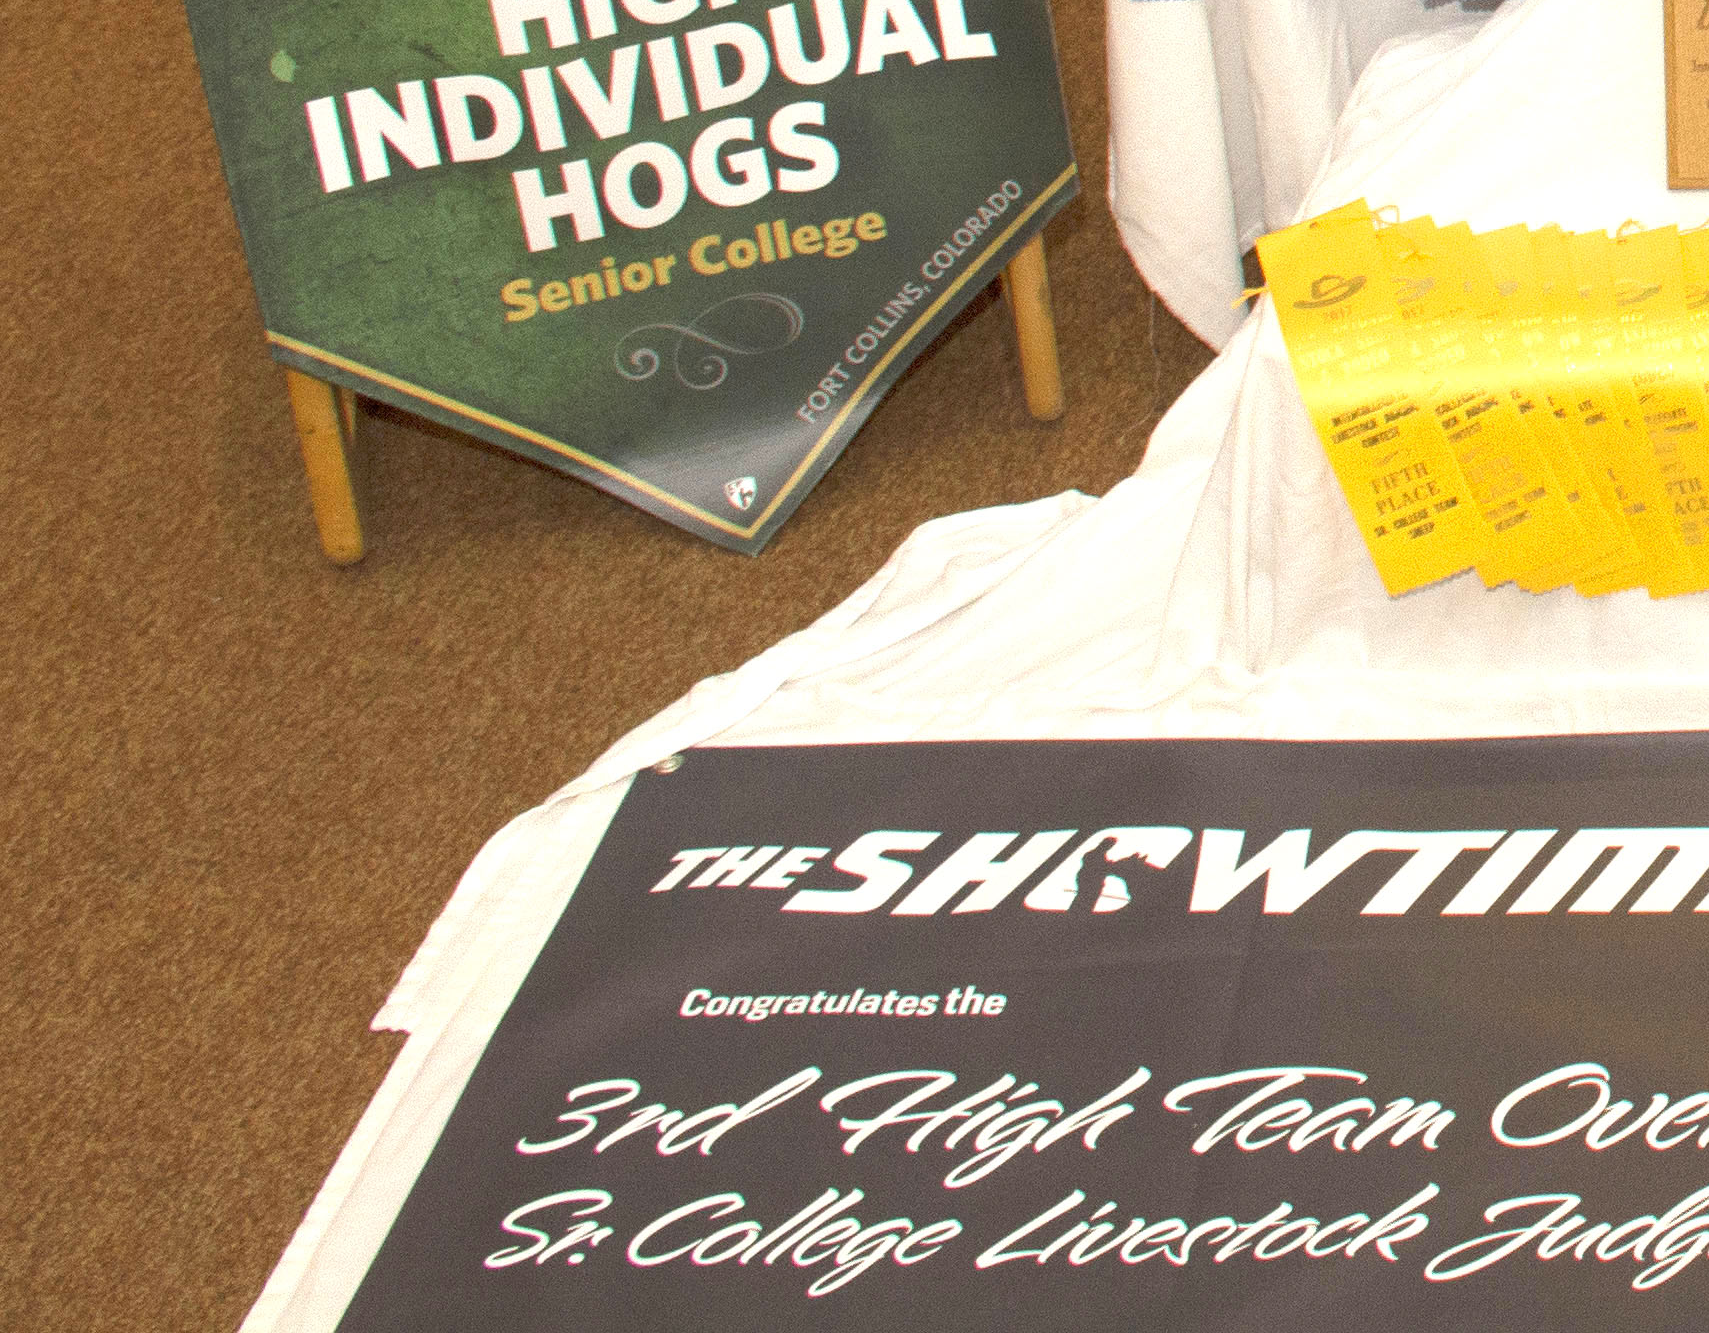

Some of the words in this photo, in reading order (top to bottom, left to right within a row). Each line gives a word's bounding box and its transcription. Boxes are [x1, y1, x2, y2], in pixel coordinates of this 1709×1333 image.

[511, 100, 839, 252] HOGS
[500, 245, 674, 322] Senior
[688, 209, 887, 276] College
[796, 362, 850, 425] FORT
[844, 280, 931, 366] COLLINS,
[921, 179, 1022, 281] COLORADO
[650, 846, 828, 892] THE
[680, 987, 938, 1019] Congratulates
[942, 985, 1006, 1015] the
[517, 1067, 822, 1156] 3rd
[820, 1066, 1153, 1188] High
[1163, 1067, 1457, 1152] Team
[485, 1189, 613, 1270] Sr.
[628, 1190, 963, 1296] College
[976, 1190, 1430, 1269] Livestock
